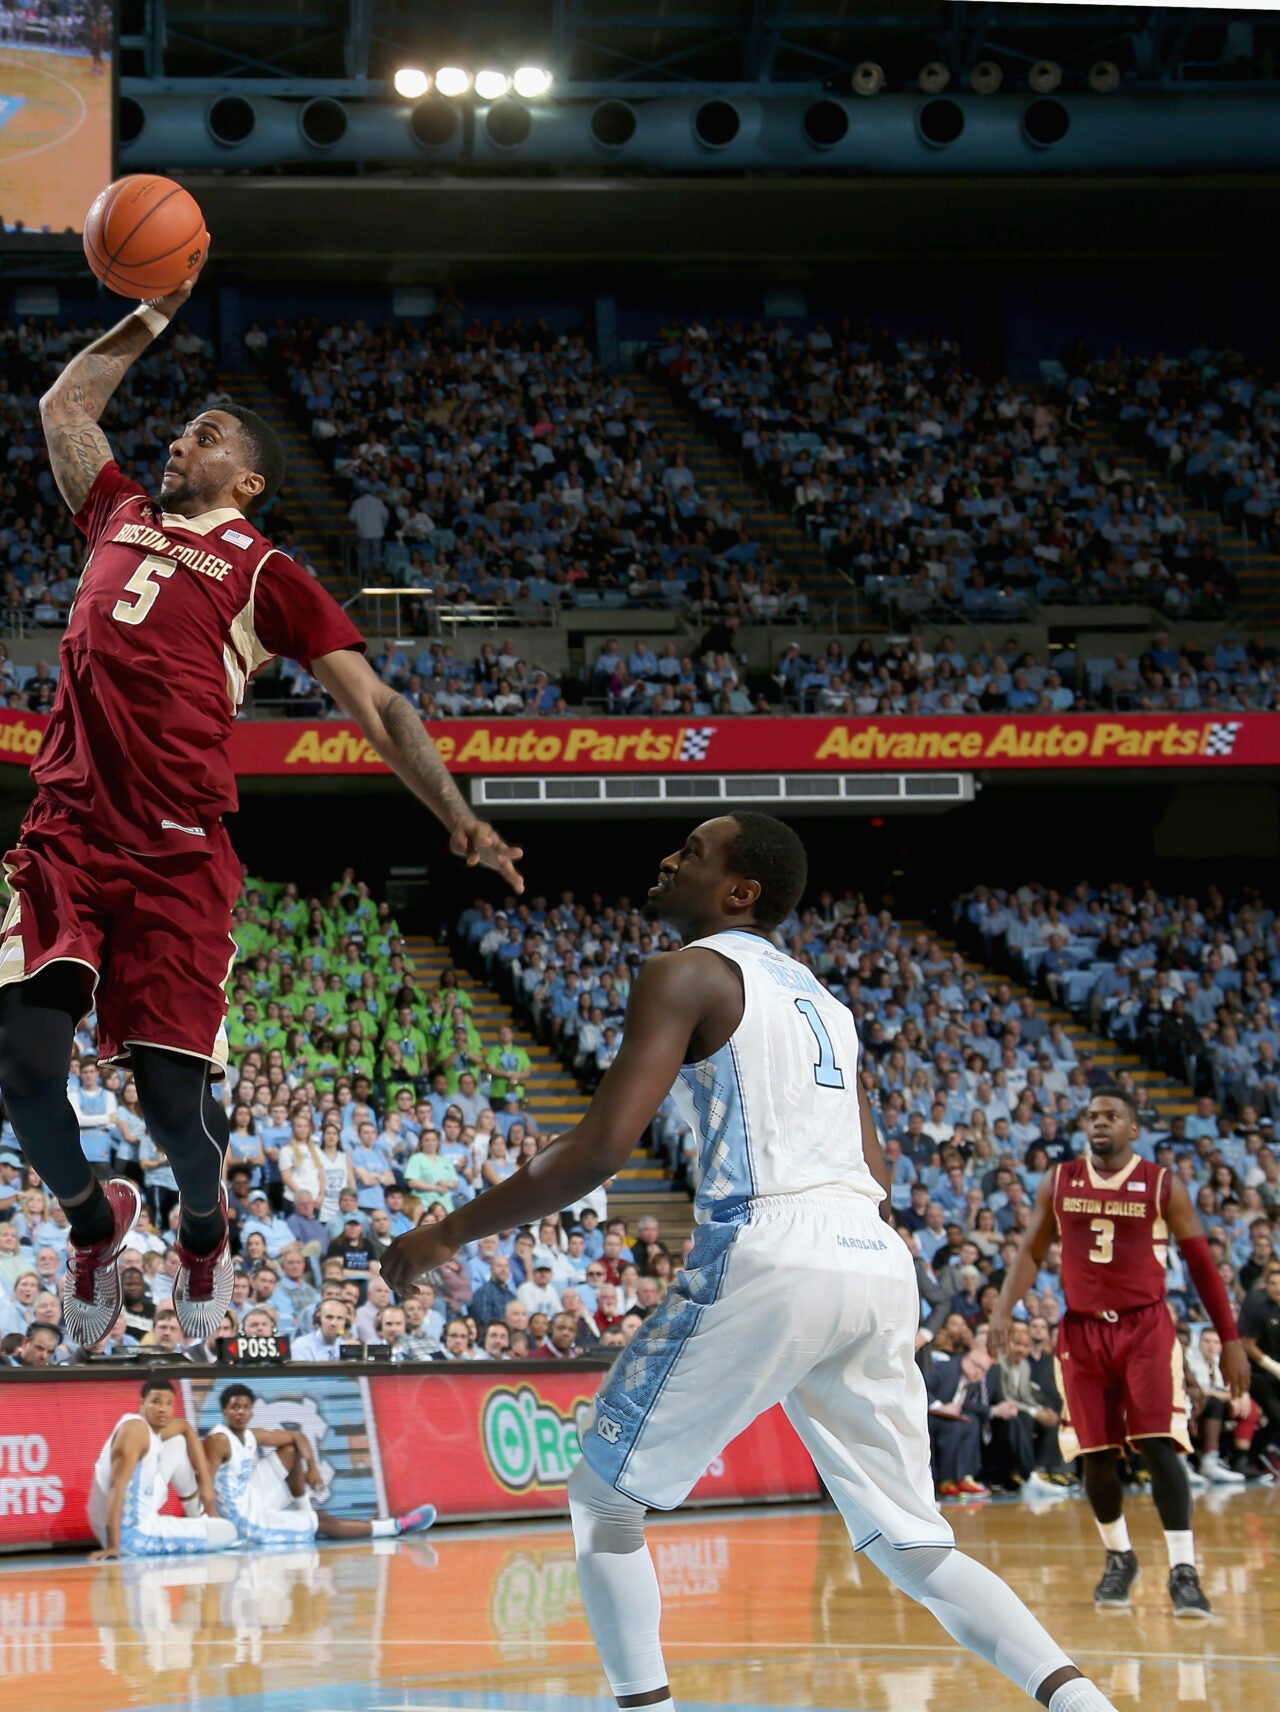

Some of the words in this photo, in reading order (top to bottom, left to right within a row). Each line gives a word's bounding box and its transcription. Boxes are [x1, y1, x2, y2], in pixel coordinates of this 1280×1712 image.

[112, 523, 171, 552] BOSTON
[168, 544, 233, 582] COLLEGE
[112, 554, 178, 625] 5
[456, 729, 562, 763] Auto
[563, 728, 673, 762] Parts
[815, 726, 984, 759] Advance
[985, 725, 1088, 757] Auto
[1090, 723, 1198, 756] Parts
[794, 998, 845, 1089] 1
[1062, 1196, 1102, 1214] BOSTON
[1104, 1201, 1147, 1218] COLLEGE
[836, 1234, 888, 1251] CAROLINA
[1089, 1218, 1115, 1264] 3
[237, 1337, 281, 1358] POSS.
